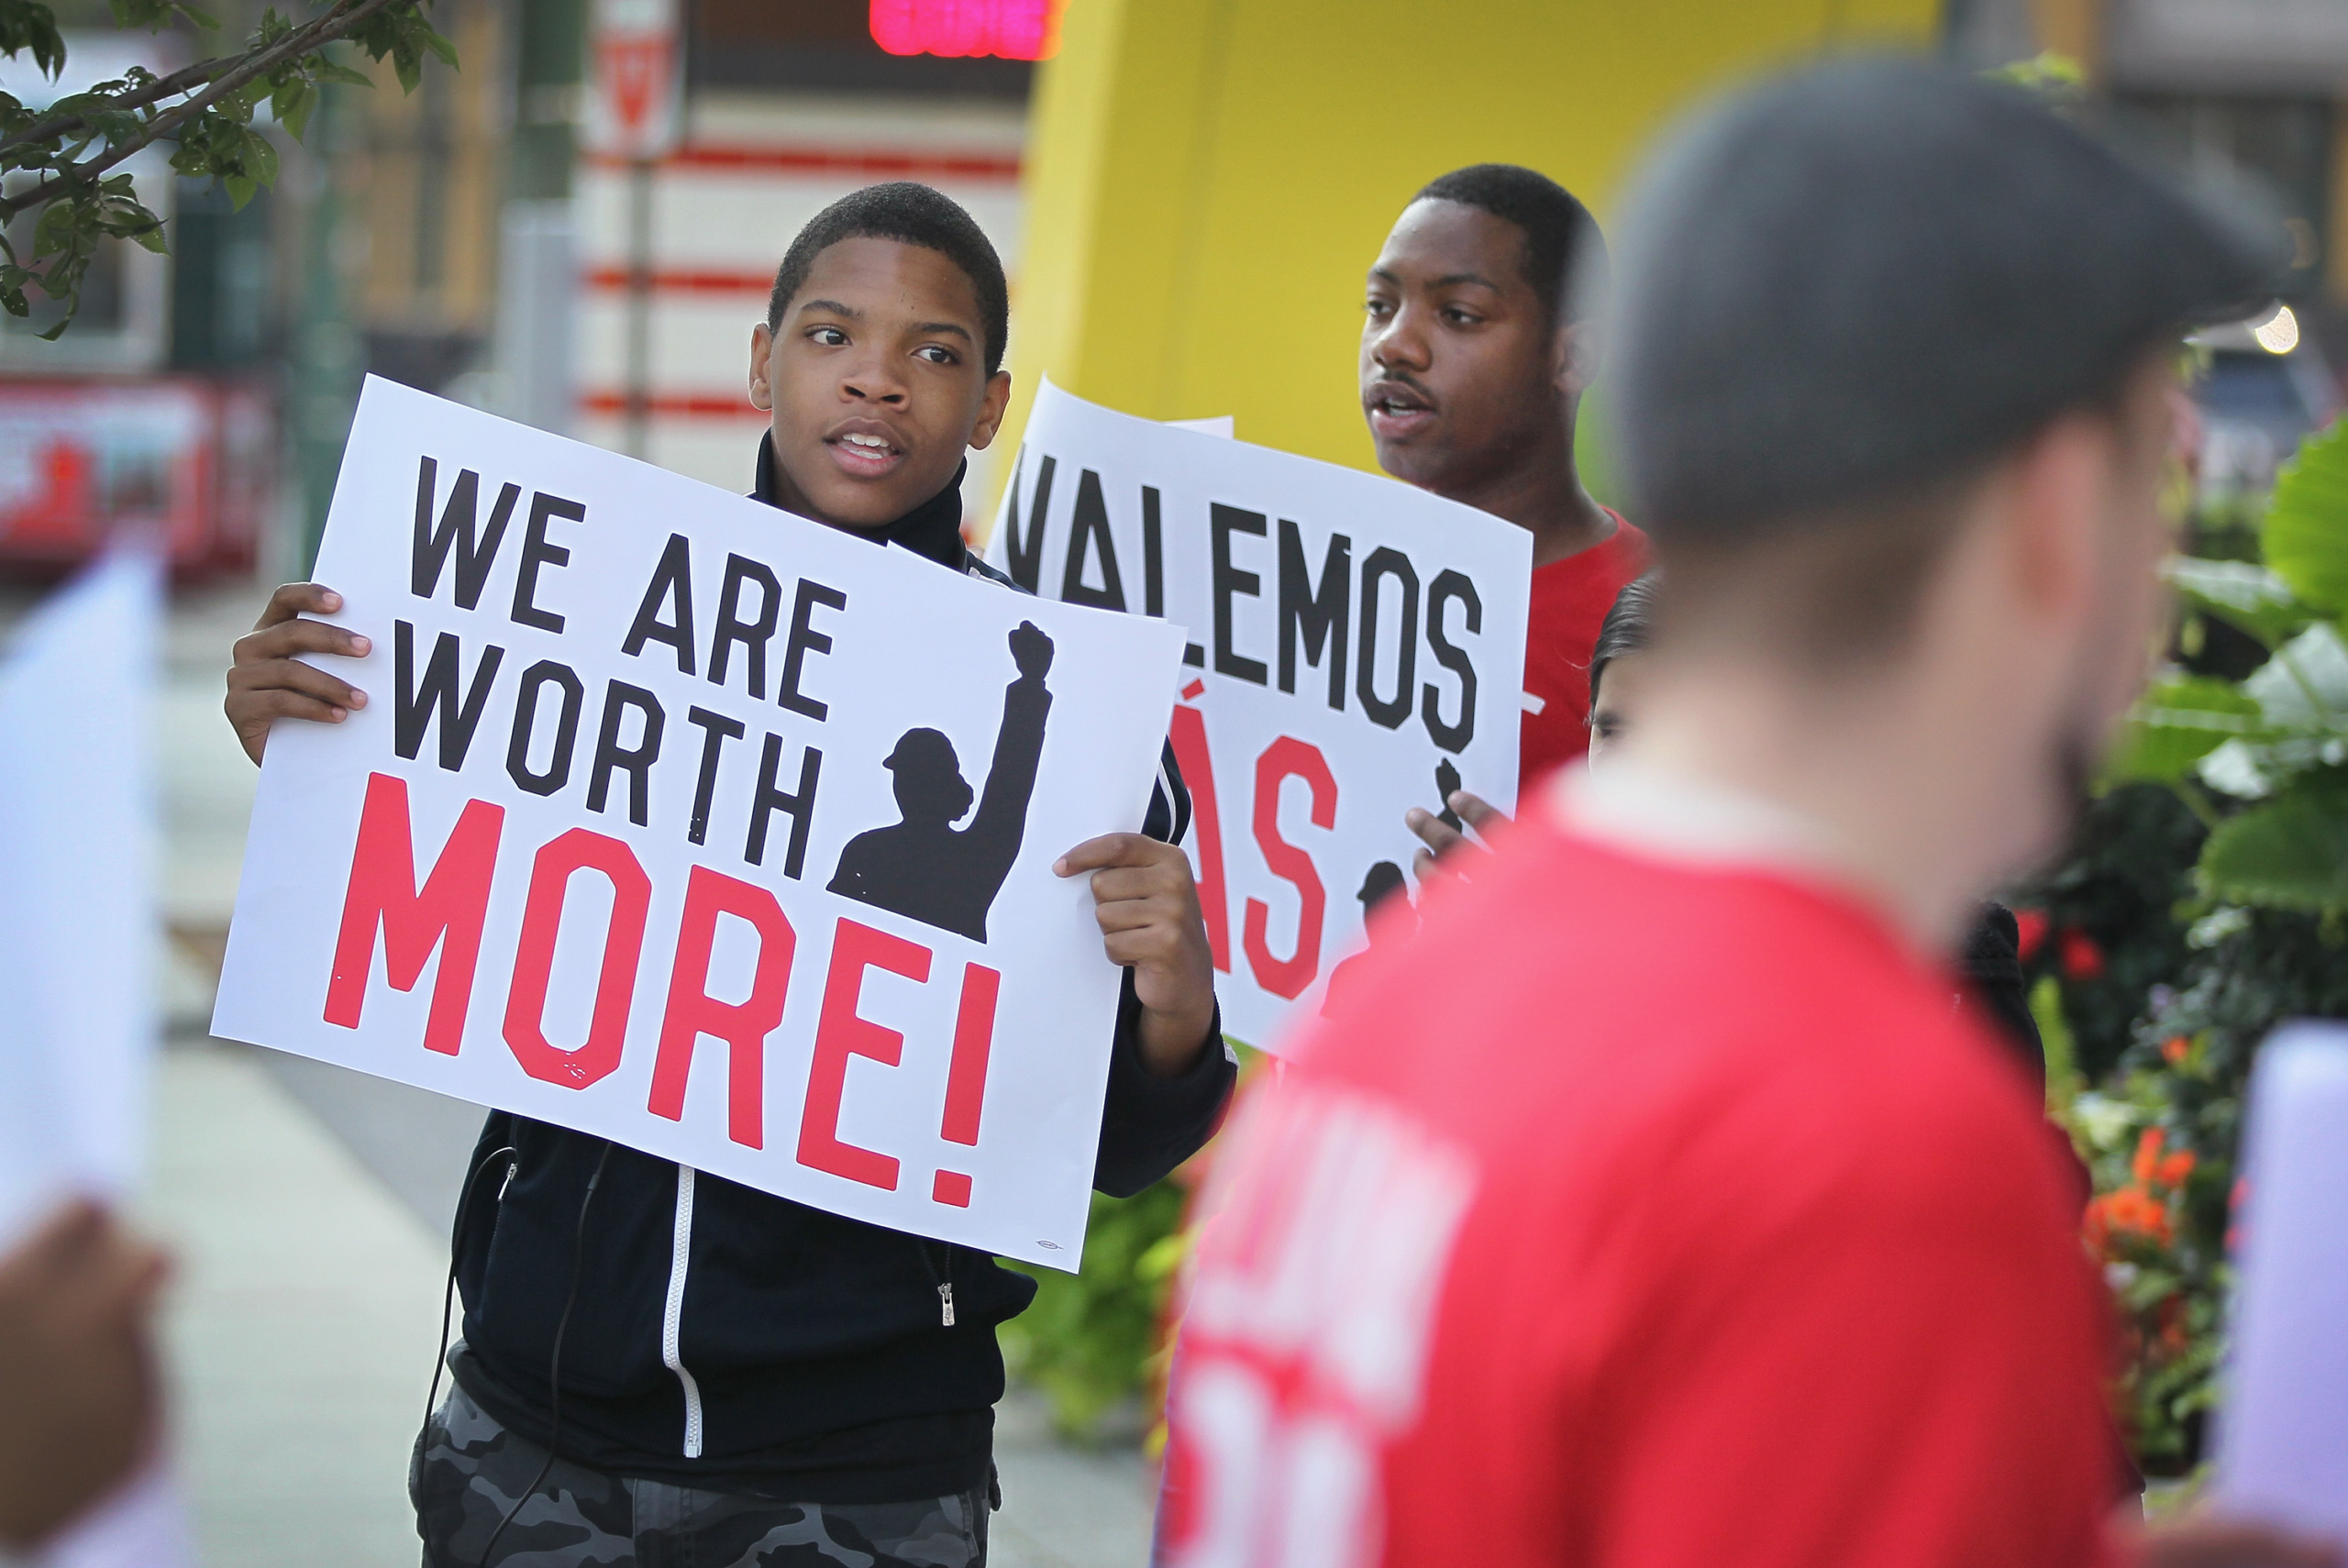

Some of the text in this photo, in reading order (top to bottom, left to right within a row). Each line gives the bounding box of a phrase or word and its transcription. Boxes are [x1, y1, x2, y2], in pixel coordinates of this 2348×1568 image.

[411, 456, 847, 722] WE ARE
[1005, 443, 1482, 755] VALEMOS
[394, 619, 823, 880] WORTH
[1168, 678, 1338, 1000] ÁS
[323, 770, 1001, 1208] MORE!
